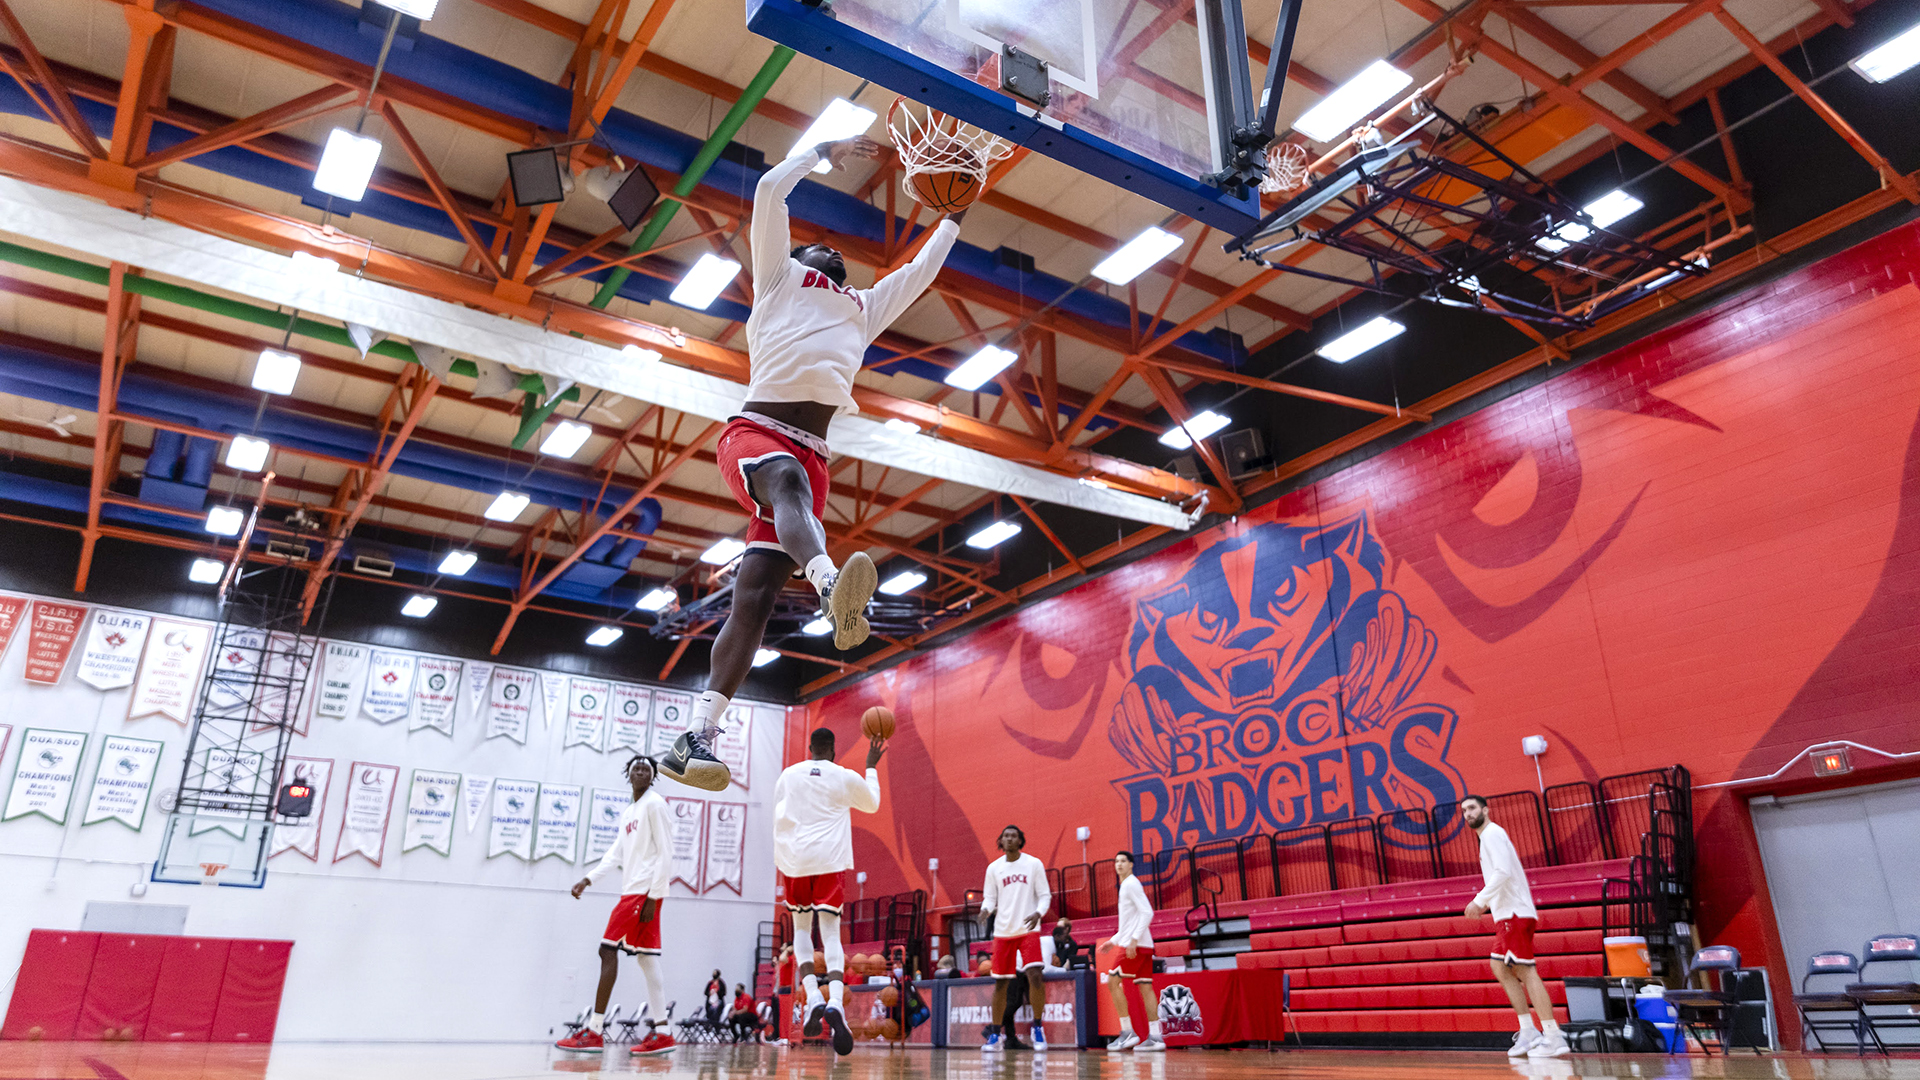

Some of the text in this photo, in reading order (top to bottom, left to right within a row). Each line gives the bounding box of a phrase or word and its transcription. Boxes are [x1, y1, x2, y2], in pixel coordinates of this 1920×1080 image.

[1168, 690, 1370, 778] BROCK
[18, 771, 73, 783] CHAMPIONS
[97, 777, 149, 790] CHAMPIONS
[1123, 711, 1458, 878] BADGERS
[409, 807, 452, 818] CHAMPIONS
[1002, 873, 1028, 888] BROCK
